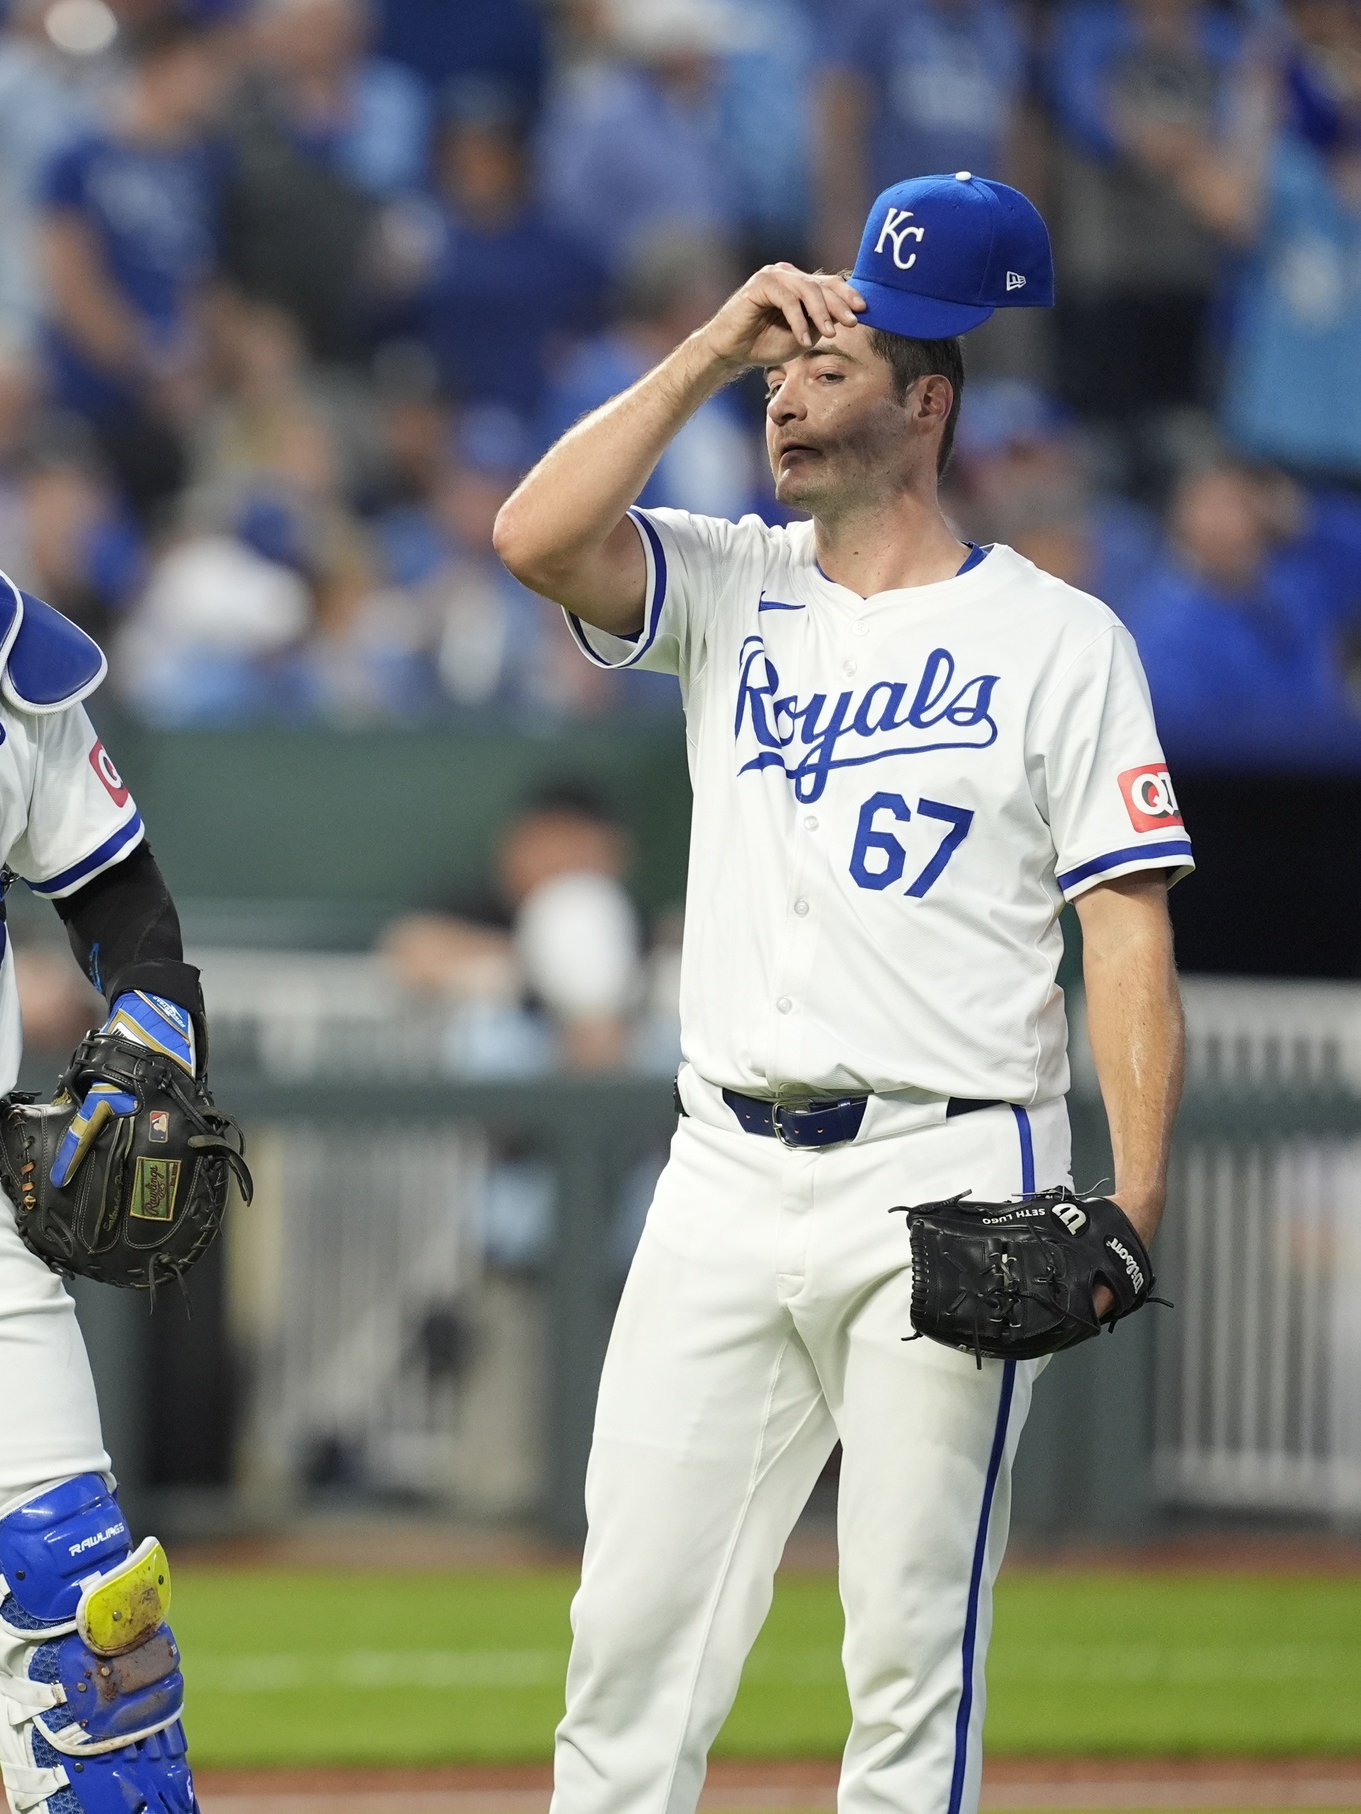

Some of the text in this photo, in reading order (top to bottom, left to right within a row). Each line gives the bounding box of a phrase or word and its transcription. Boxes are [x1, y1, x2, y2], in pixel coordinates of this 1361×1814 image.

[874, 207, 925, 270] KC
[734, 635, 1001, 804] Royals
[848, 791, 974, 899] 67
[144, 1164, 165, 1216] Rawlings
[982, 1208, 1046, 1225] SETH LUGO
[1108, 1237, 1144, 1295] Wilson
[69, 1522, 125, 1557] RAWLINGS
